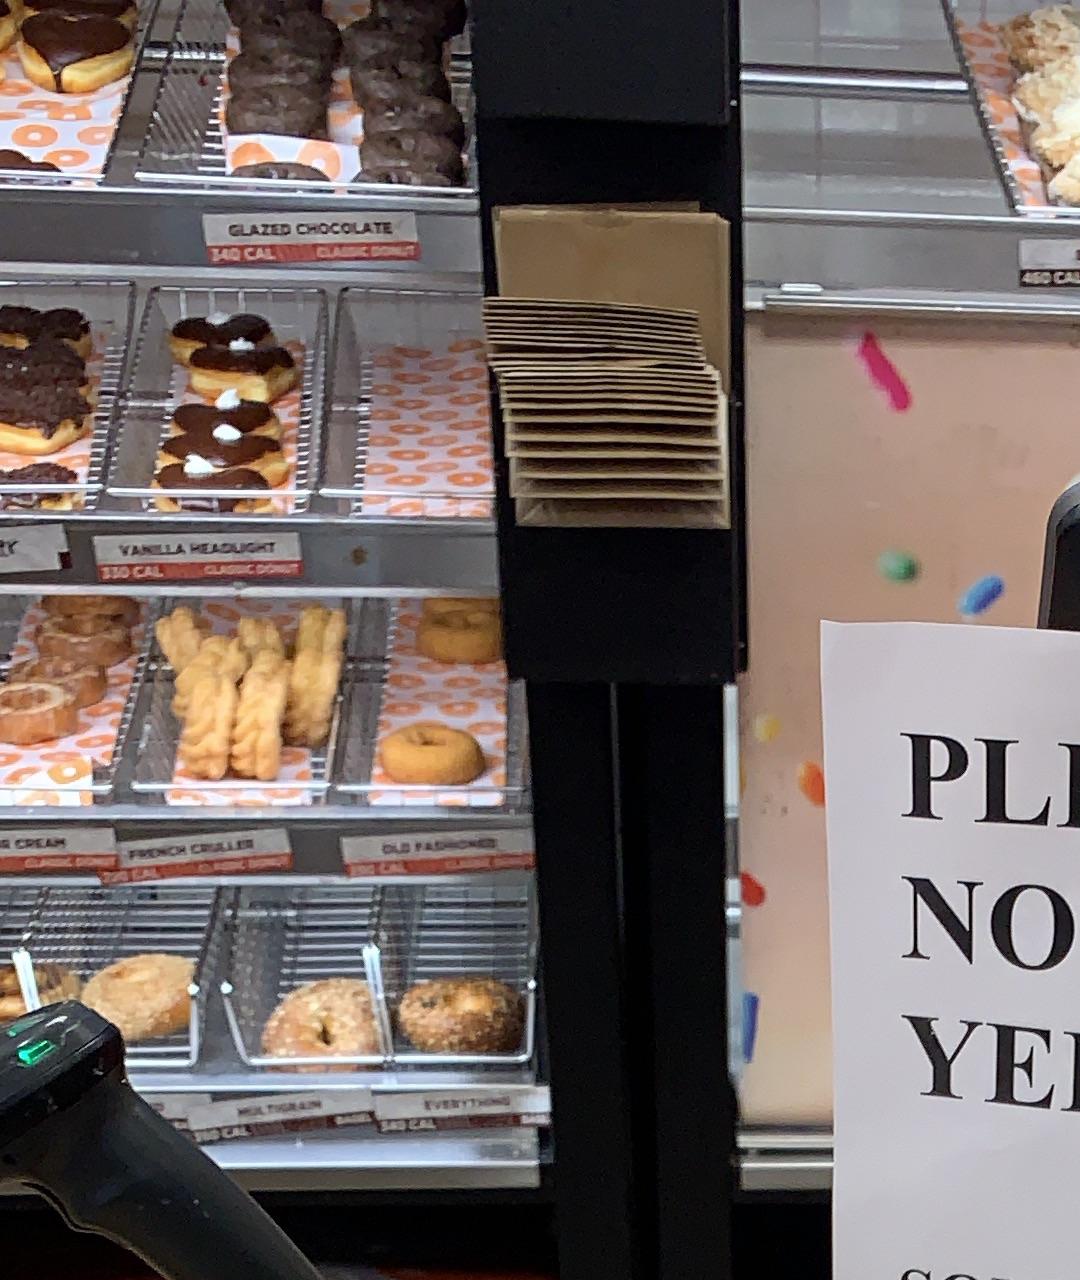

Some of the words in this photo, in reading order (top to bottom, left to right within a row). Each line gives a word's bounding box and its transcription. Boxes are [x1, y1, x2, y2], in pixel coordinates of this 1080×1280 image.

[228, 224, 291, 237] GLAZED
[296, 222, 393, 235] CHOCOLATE
[244, 247, 274, 260] CAL
[120, 544, 186, 556] VANILLA
[190, 542, 276, 554] HEADLIGHT
[132, 566, 164, 578] CAL
[15, 839, 66, 849] CREAM
[129, 847, 186, 860] FRENCH
[901, 876, 1076, 970] NO
